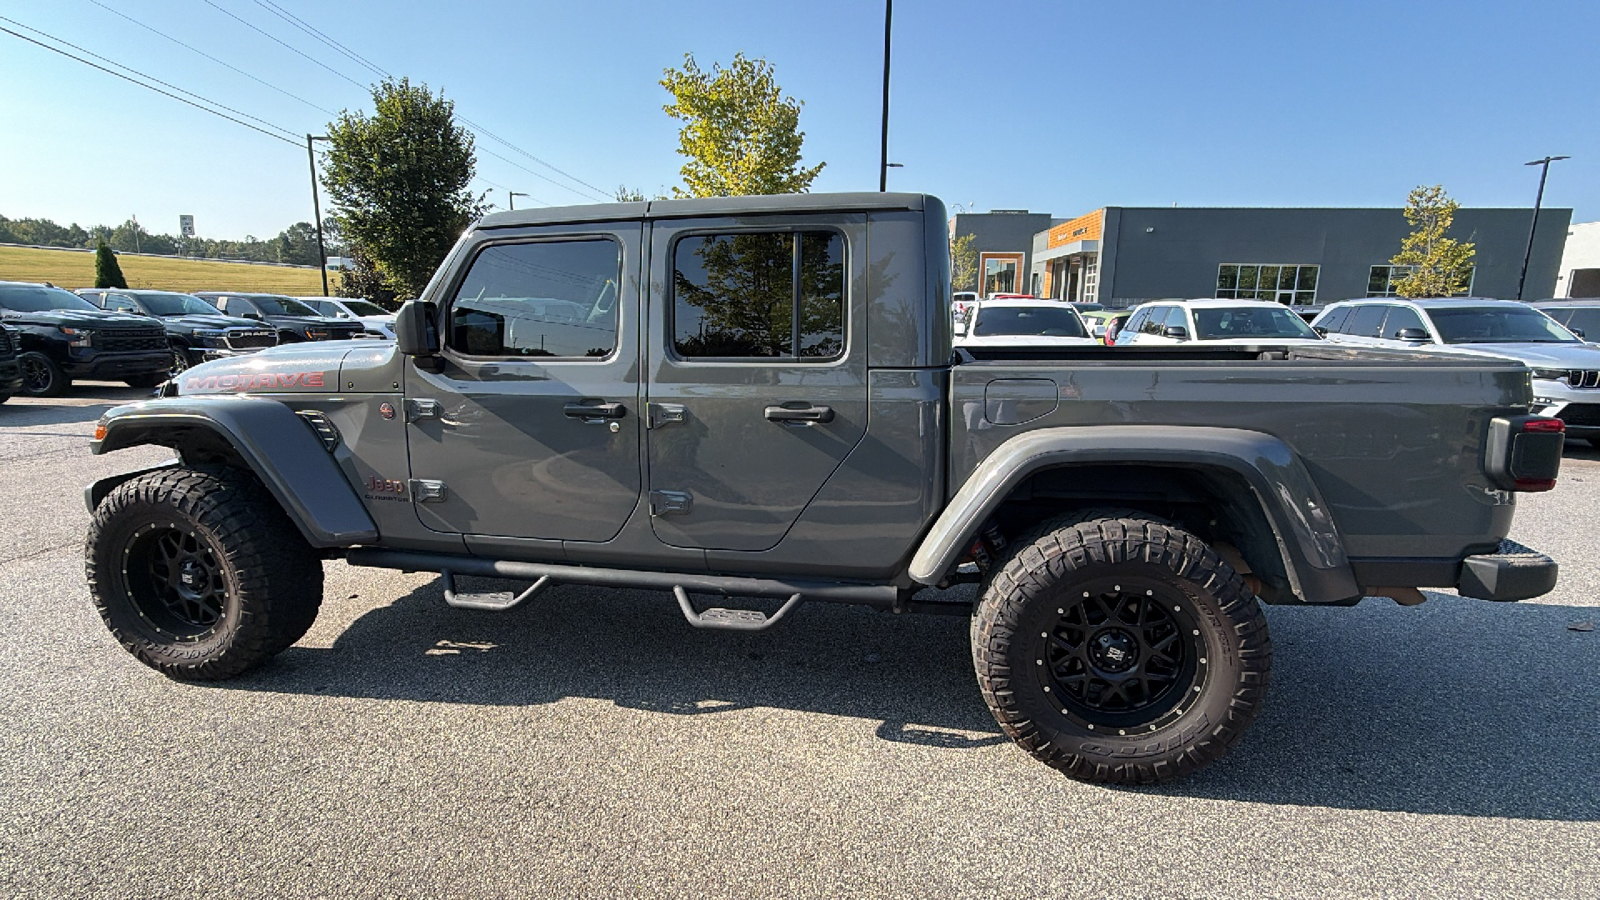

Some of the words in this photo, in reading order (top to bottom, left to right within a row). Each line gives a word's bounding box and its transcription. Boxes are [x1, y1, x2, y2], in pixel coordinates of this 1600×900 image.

[186, 371, 324, 391] MOJAVE
[369, 475, 405, 495] Jeep
[365, 494, 409, 502] GLADIATOR
[1080, 712, 1210, 759] NITTO
